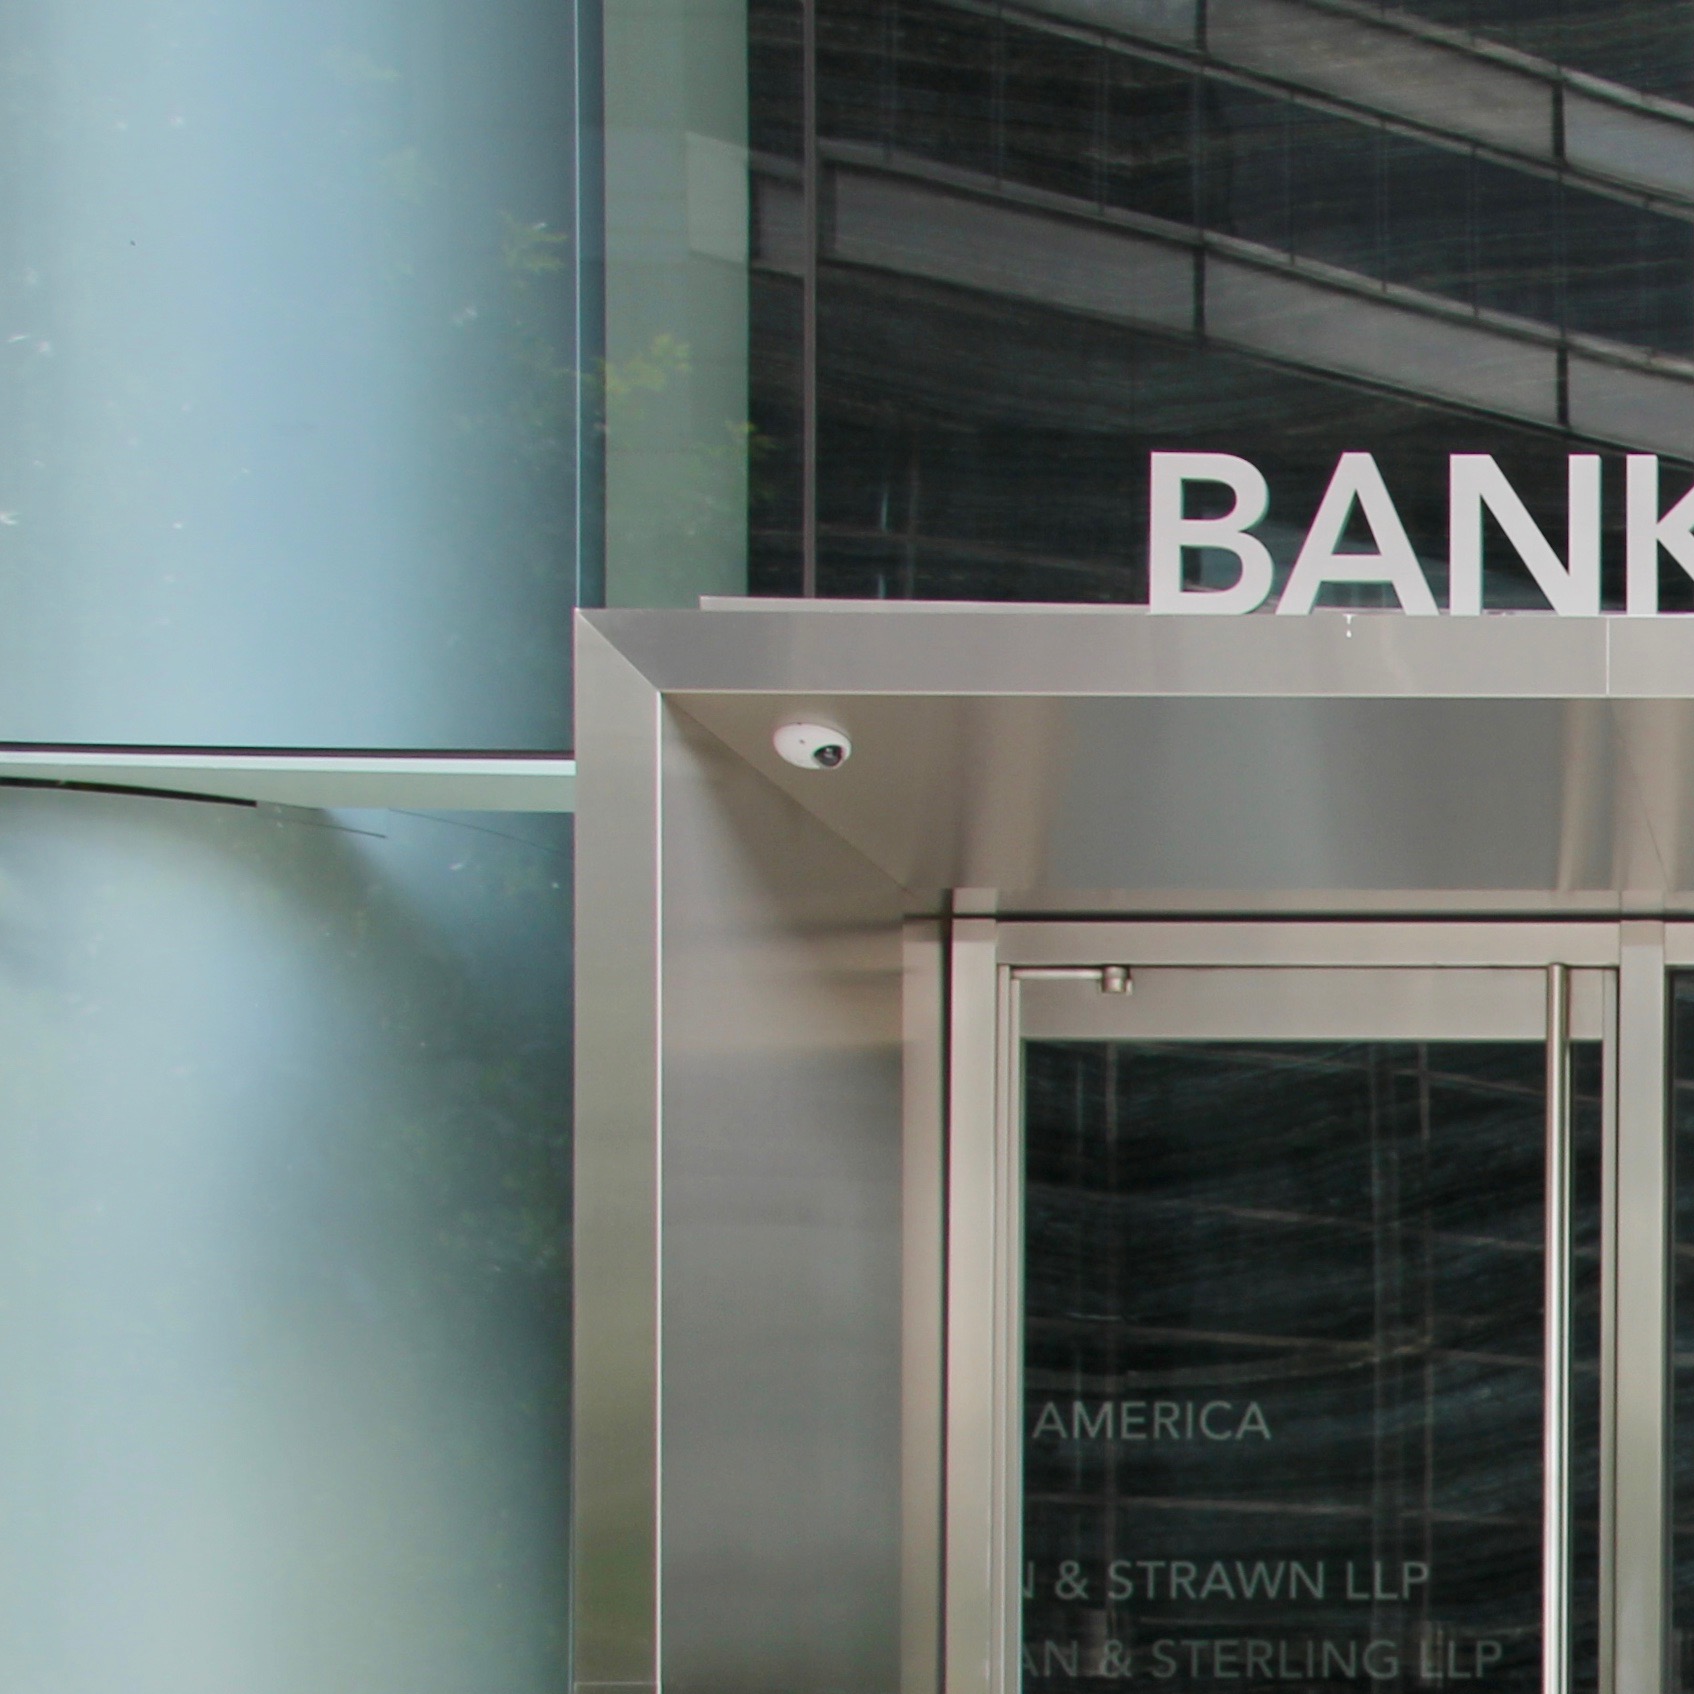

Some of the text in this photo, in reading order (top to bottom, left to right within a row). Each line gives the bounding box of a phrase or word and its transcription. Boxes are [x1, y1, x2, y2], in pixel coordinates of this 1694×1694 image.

[1032, 1401, 1272, 1440] AMERICA
[1055, 1561, 1089, 1600] &
[1107, 1561, 1324, 1600] STRAWN
[1346, 1561, 1430, 1600] LLP
[1102, 1640, 1502, 1678] & STERLING LLP
